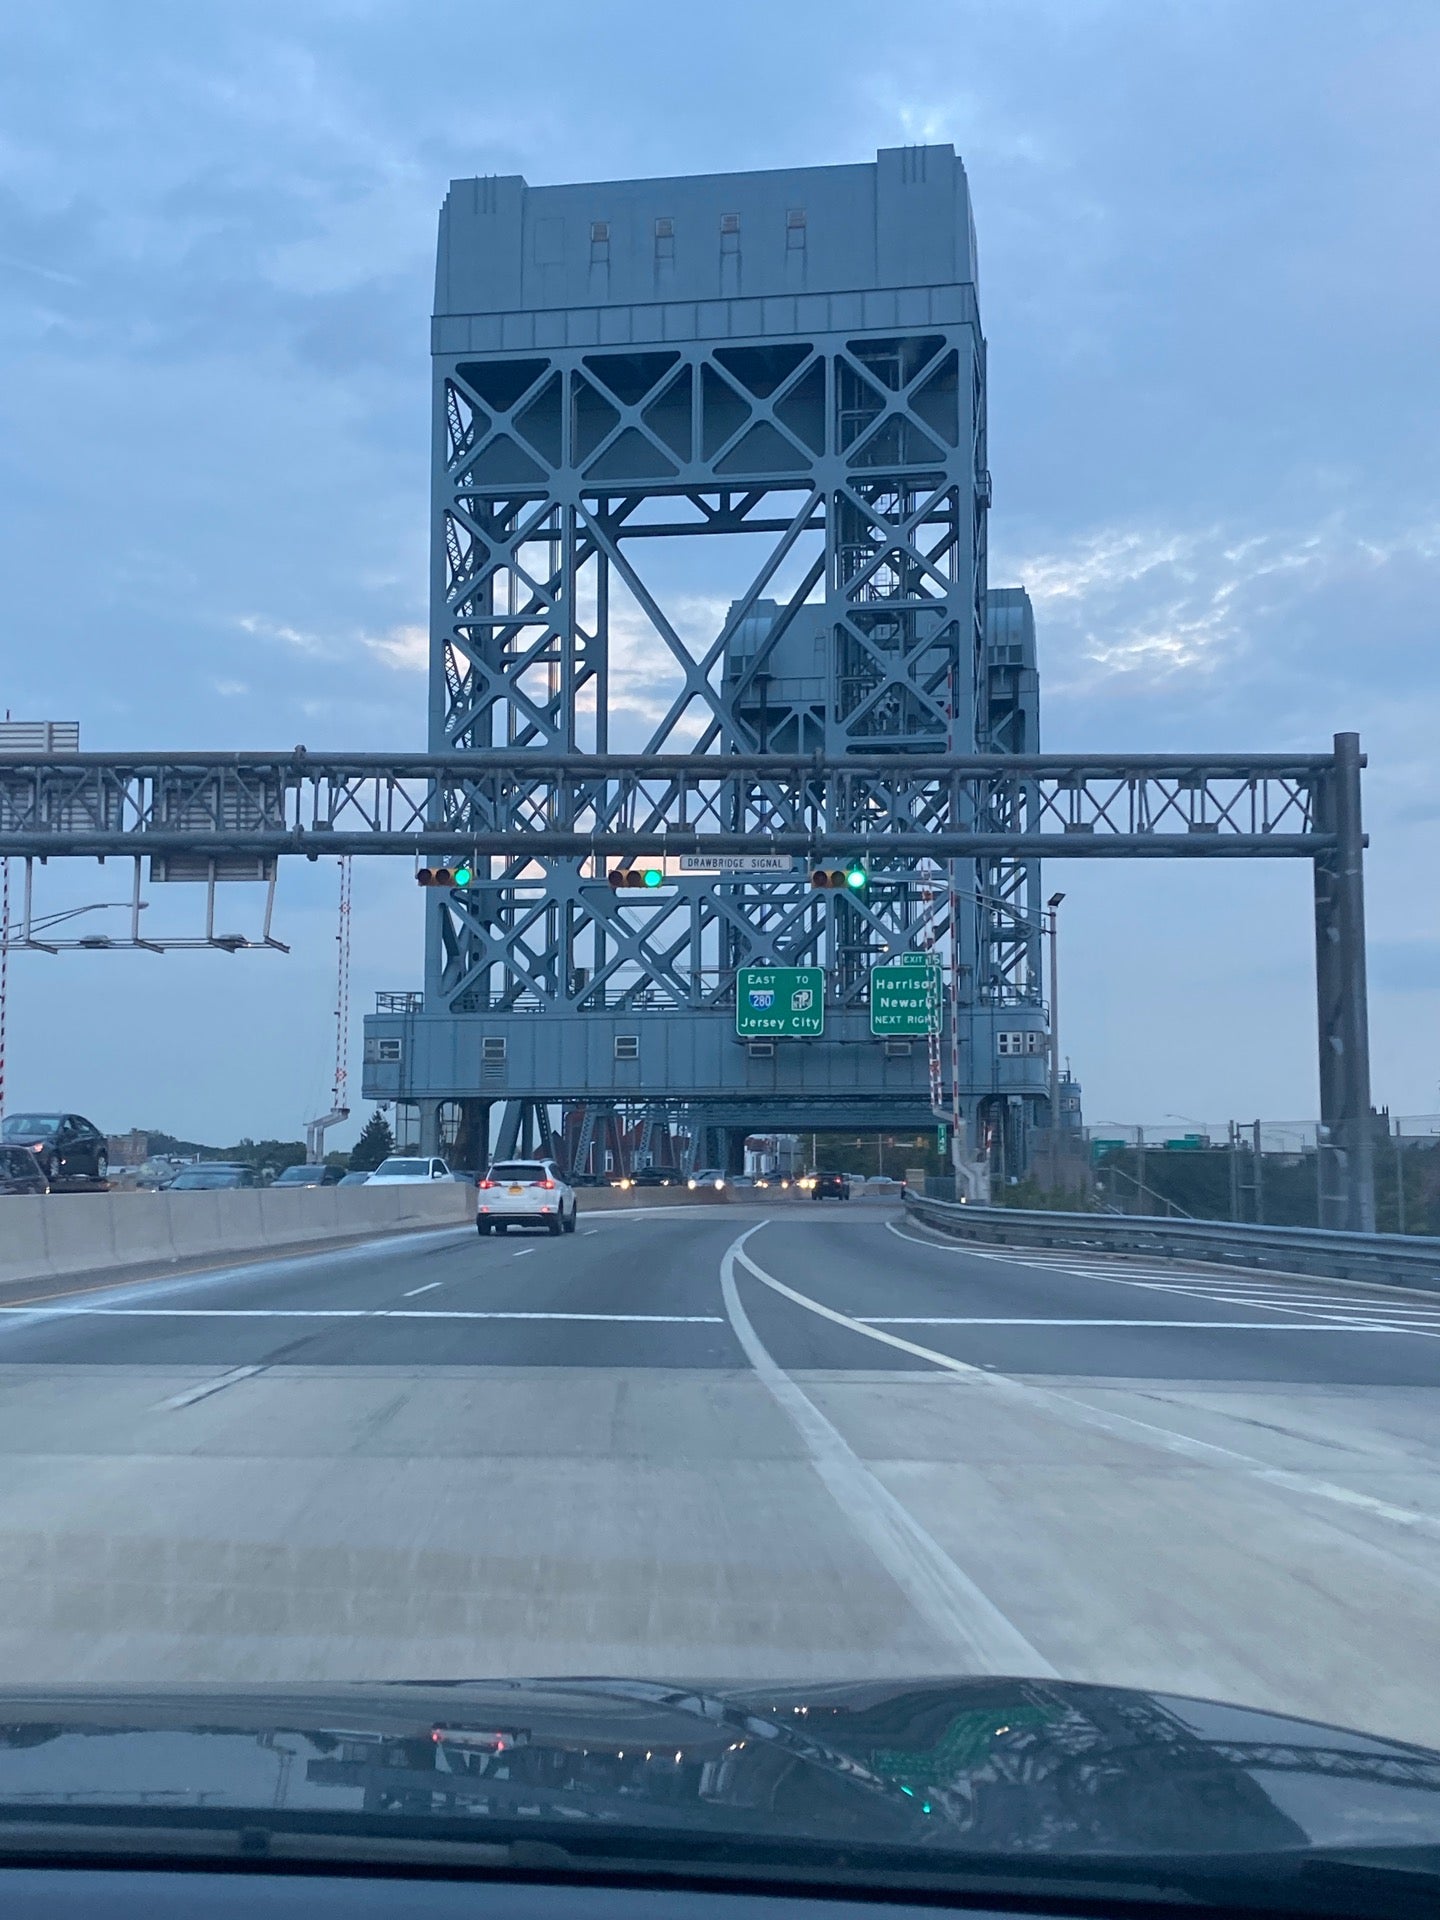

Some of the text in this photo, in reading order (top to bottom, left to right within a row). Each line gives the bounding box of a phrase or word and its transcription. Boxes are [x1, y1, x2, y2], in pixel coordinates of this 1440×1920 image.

[688, 857, 782, 868] DRAWBRIDGE SIGNAL
[904, 956, 923, 964] EXIT
[748, 975, 809, 984] EAST TO
[753, 995, 771, 1007] 280
[741, 1017, 820, 1030] Jersey City
[874, 1015, 901, 1024] NEXT
